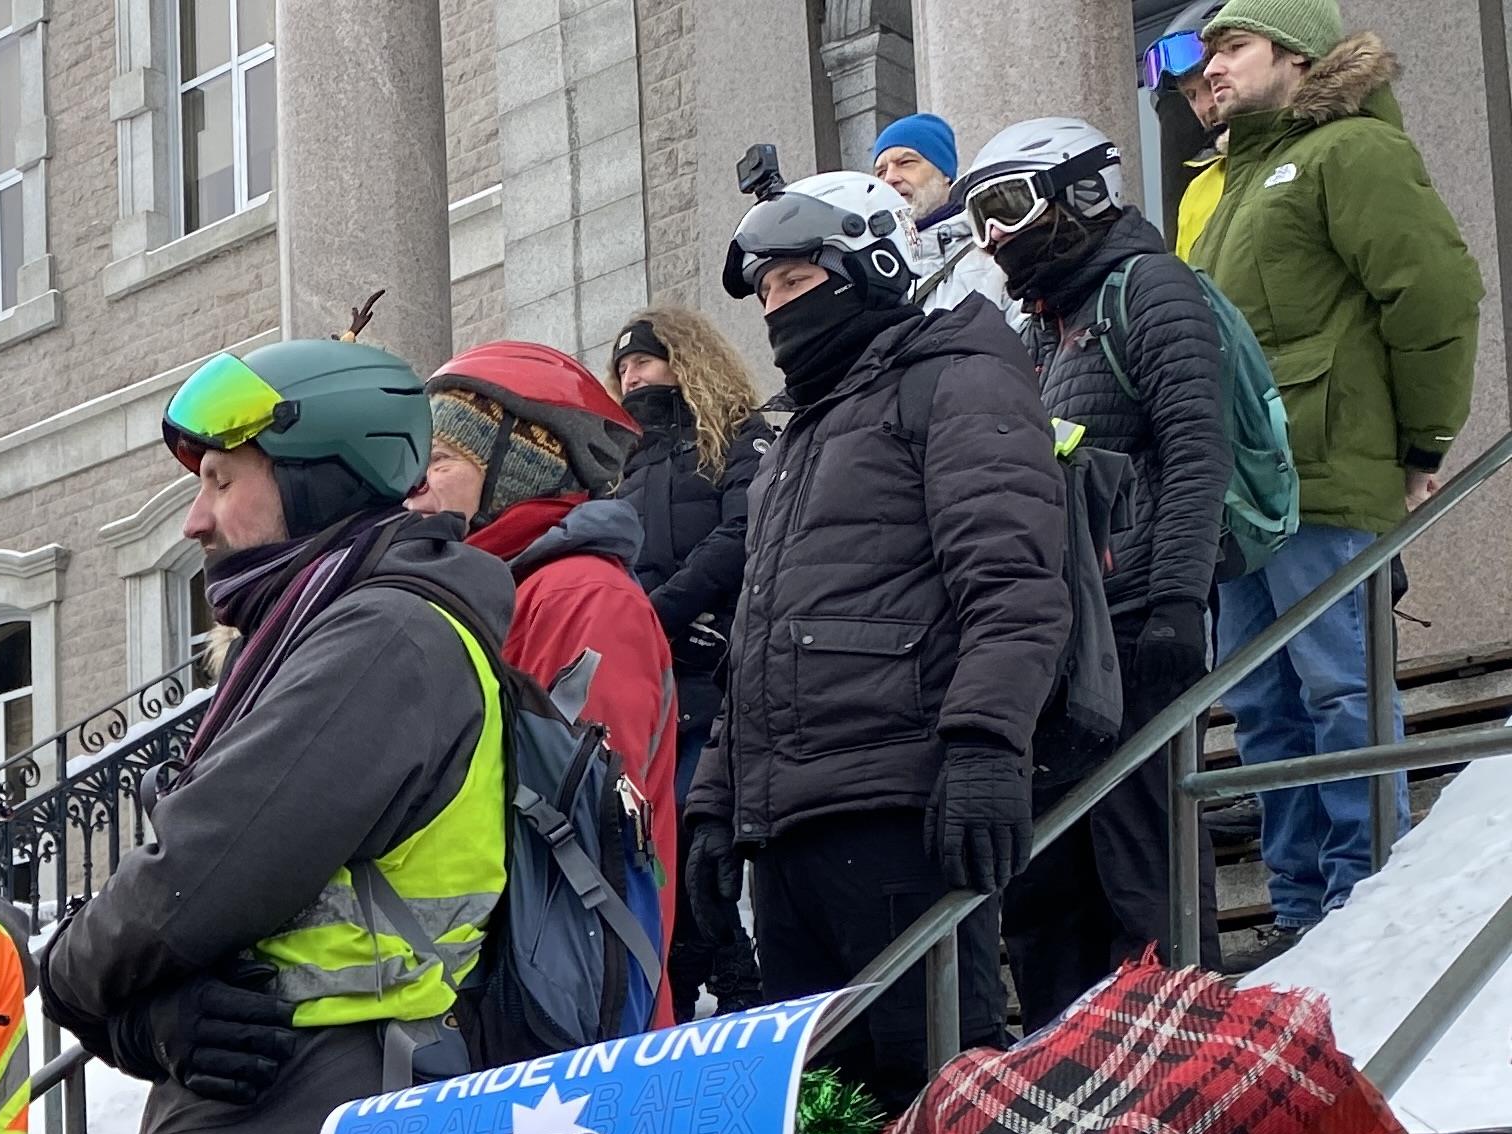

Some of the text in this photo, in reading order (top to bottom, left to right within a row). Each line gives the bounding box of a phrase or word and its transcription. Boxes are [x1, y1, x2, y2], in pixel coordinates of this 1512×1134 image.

[356, 1085, 429, 1117] WE
[436, 1057, 554, 1103] RIDE
[565, 1041, 628, 1080] IN
[636, 1007, 816, 1068] UNITY
